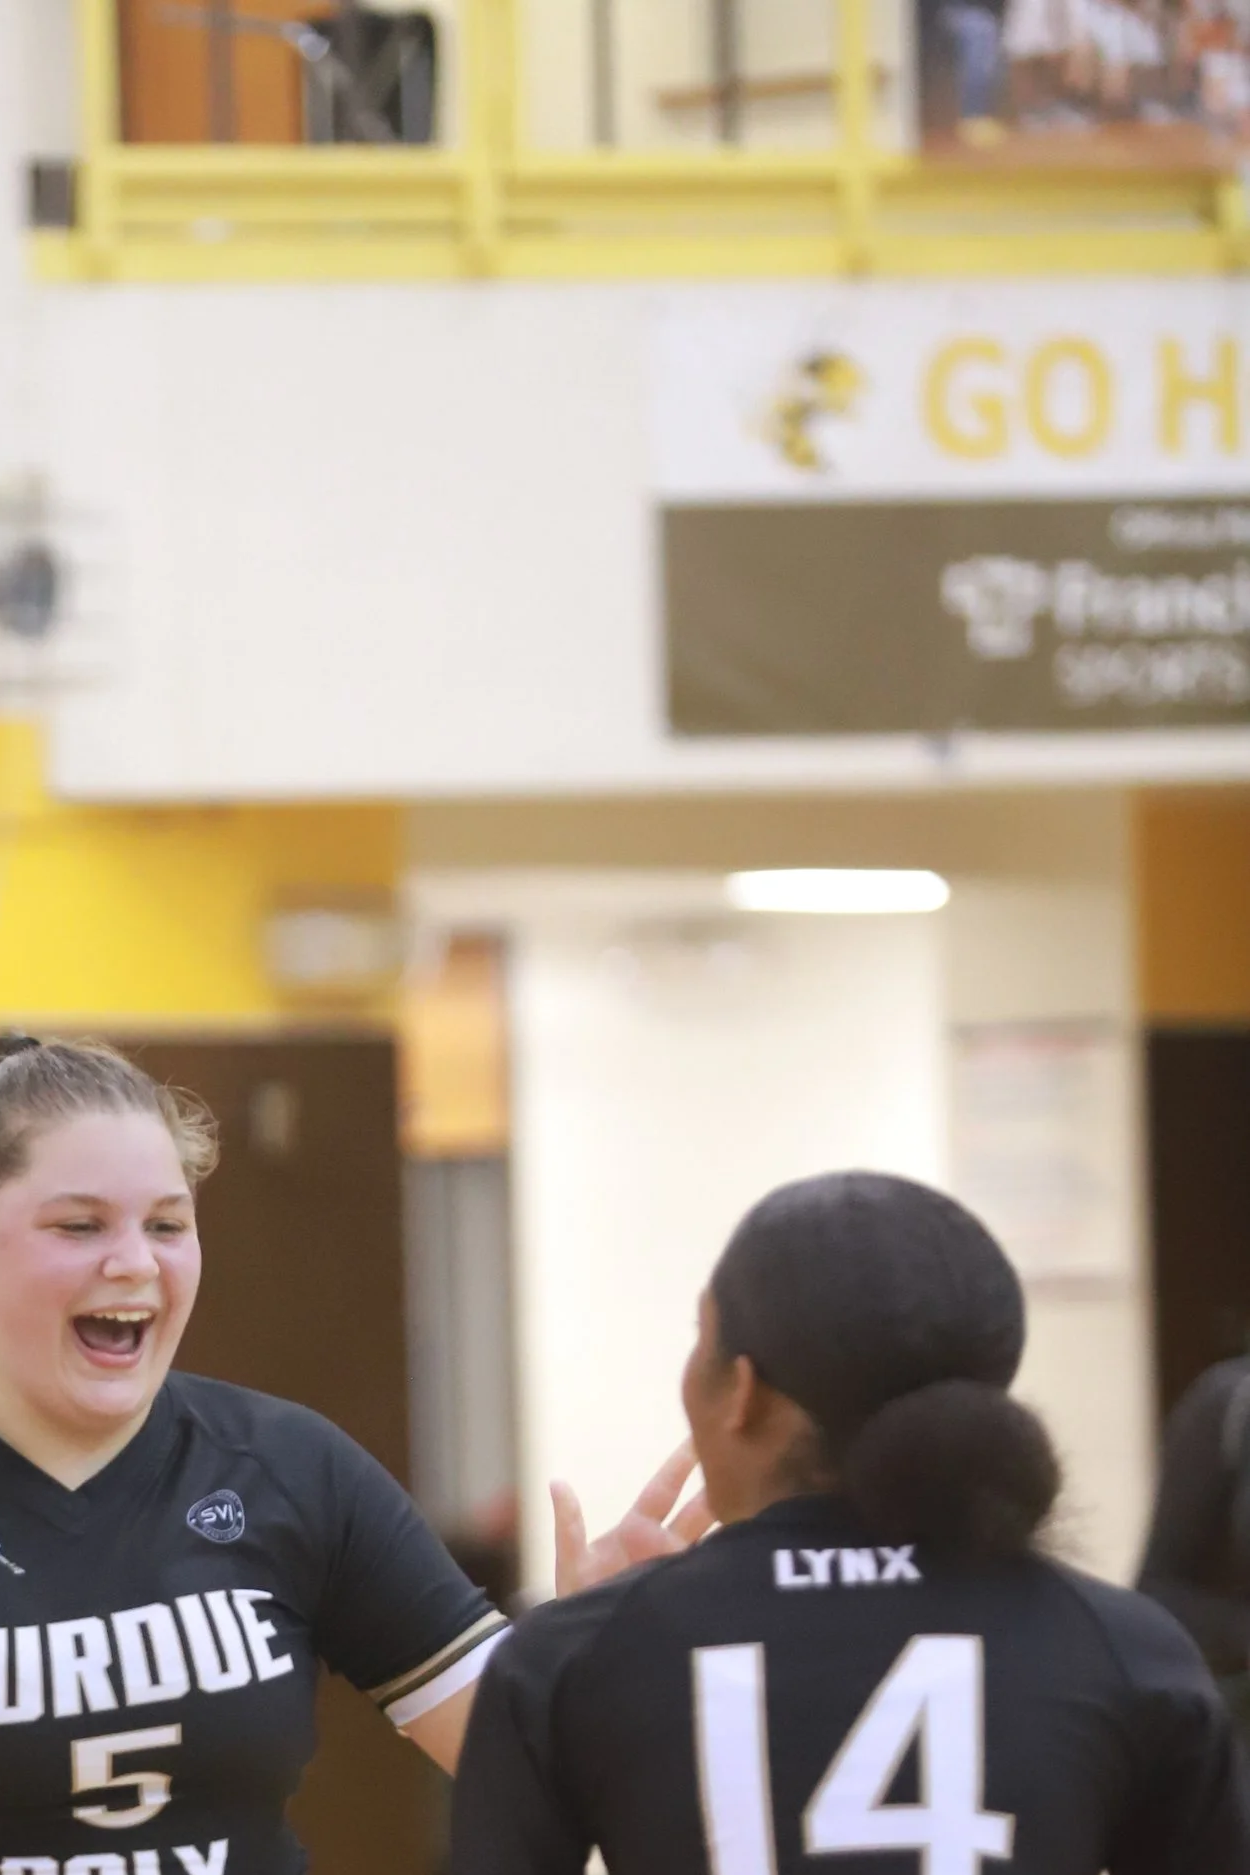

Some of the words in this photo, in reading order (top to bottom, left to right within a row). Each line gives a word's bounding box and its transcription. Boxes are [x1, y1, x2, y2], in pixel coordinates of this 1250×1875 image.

[922, 333, 1115, 461] GO
[200, 1504, 234, 1524] SVI
[772, 1544, 922, 1590] LYNX
[70, 1723, 183, 1830] 5
